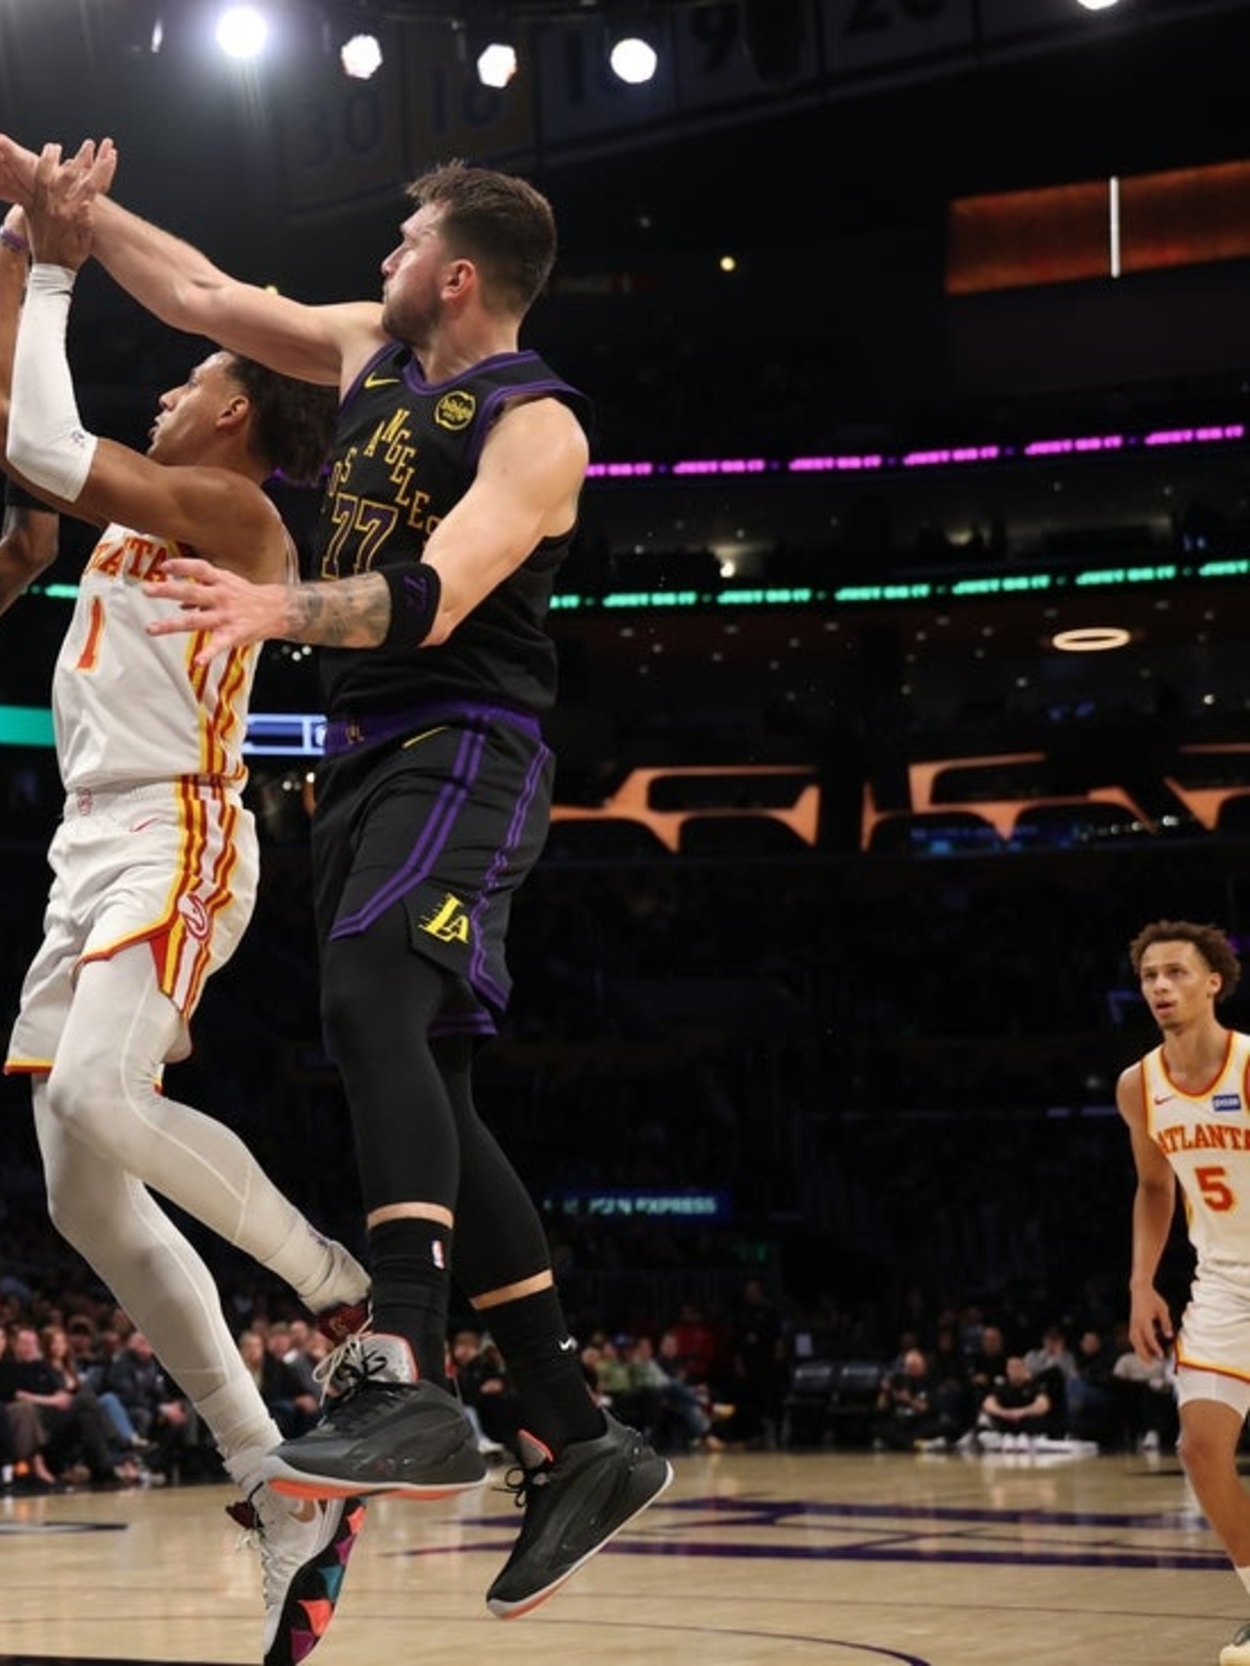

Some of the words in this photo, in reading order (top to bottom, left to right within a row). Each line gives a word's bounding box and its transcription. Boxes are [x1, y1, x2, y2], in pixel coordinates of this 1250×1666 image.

[321, 492, 399, 581] 77
[77, 595, 102, 669] 1
[418, 892, 469, 944] LA
[1194, 1166, 1236, 1212] 5
